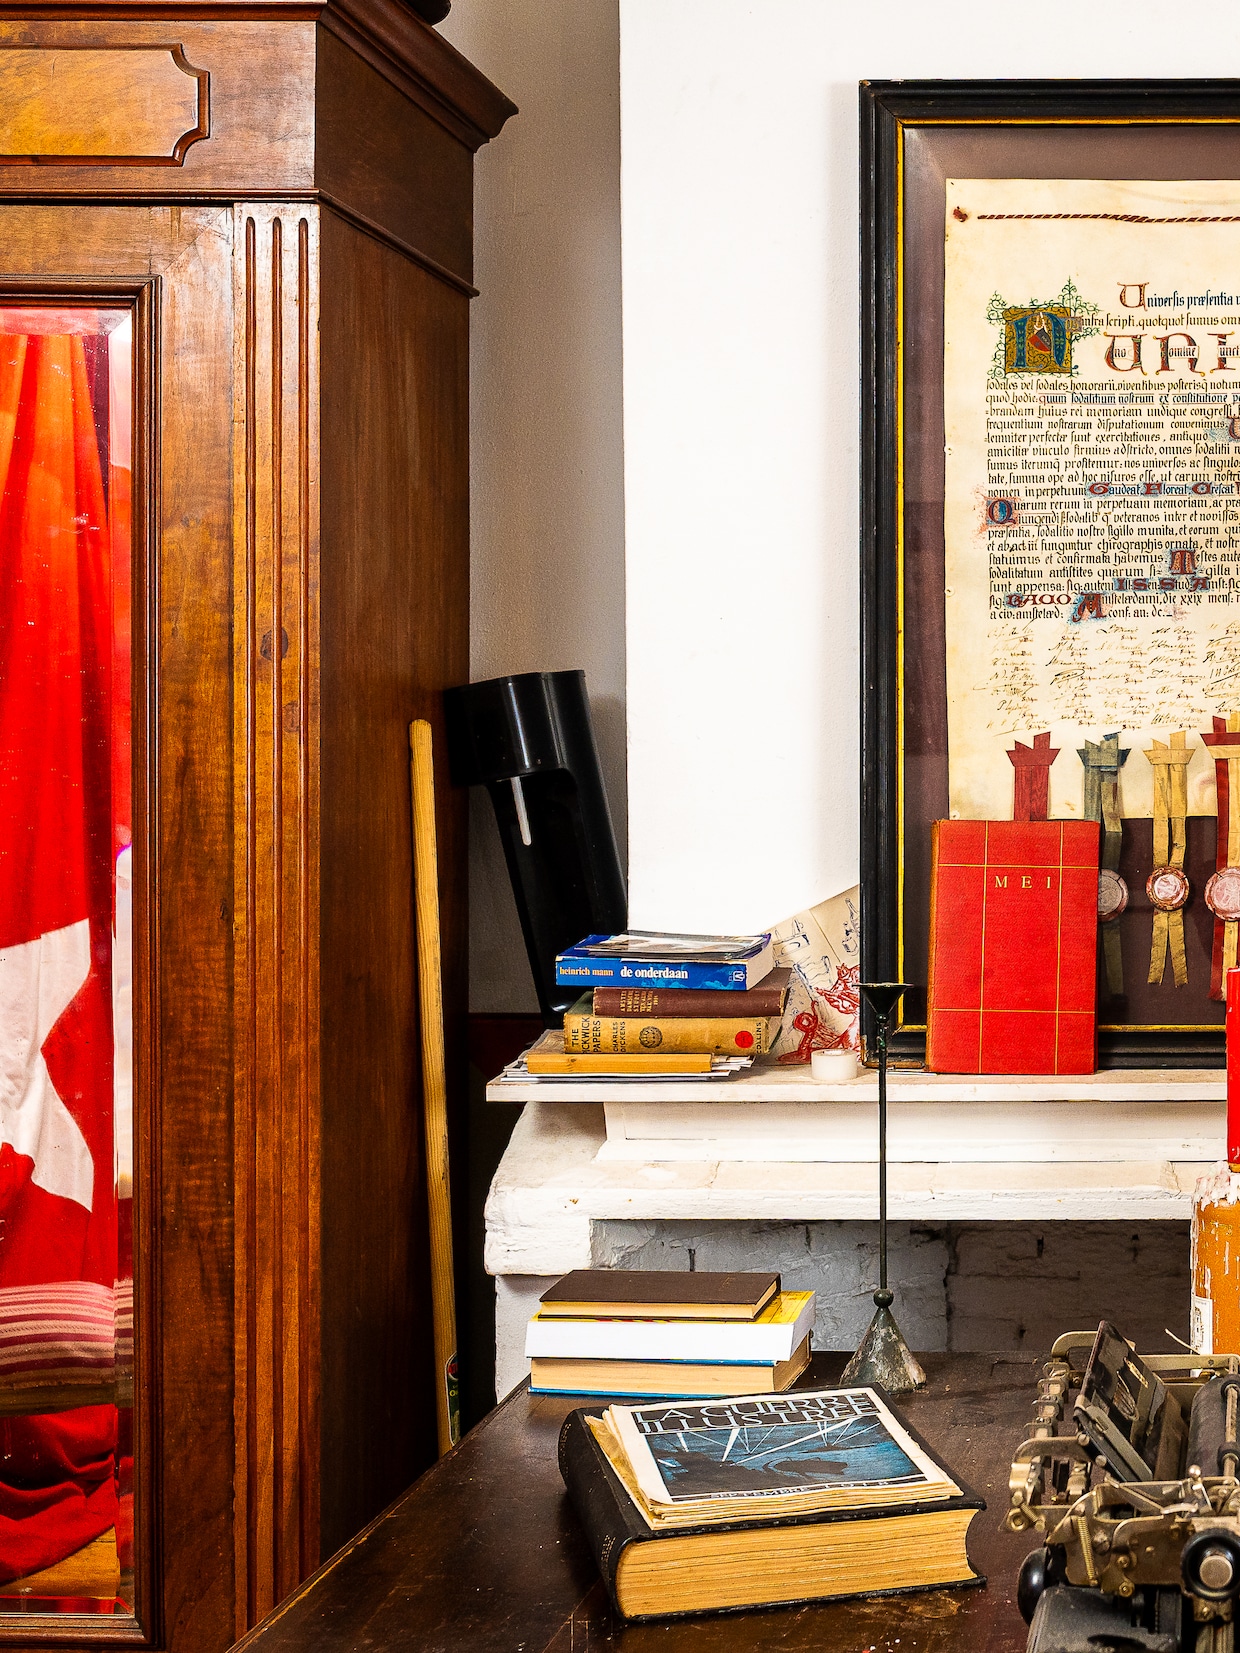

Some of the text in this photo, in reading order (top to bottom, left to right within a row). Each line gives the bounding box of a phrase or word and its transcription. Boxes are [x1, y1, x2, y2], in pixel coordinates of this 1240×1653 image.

[559, 966, 688, 979] heinrich mann de onderdaan
[571, 1028, 579, 1047] THE
[593, 1020, 601, 1053] PAPERS
[637, 1393, 872, 1423] LA GUERRE
